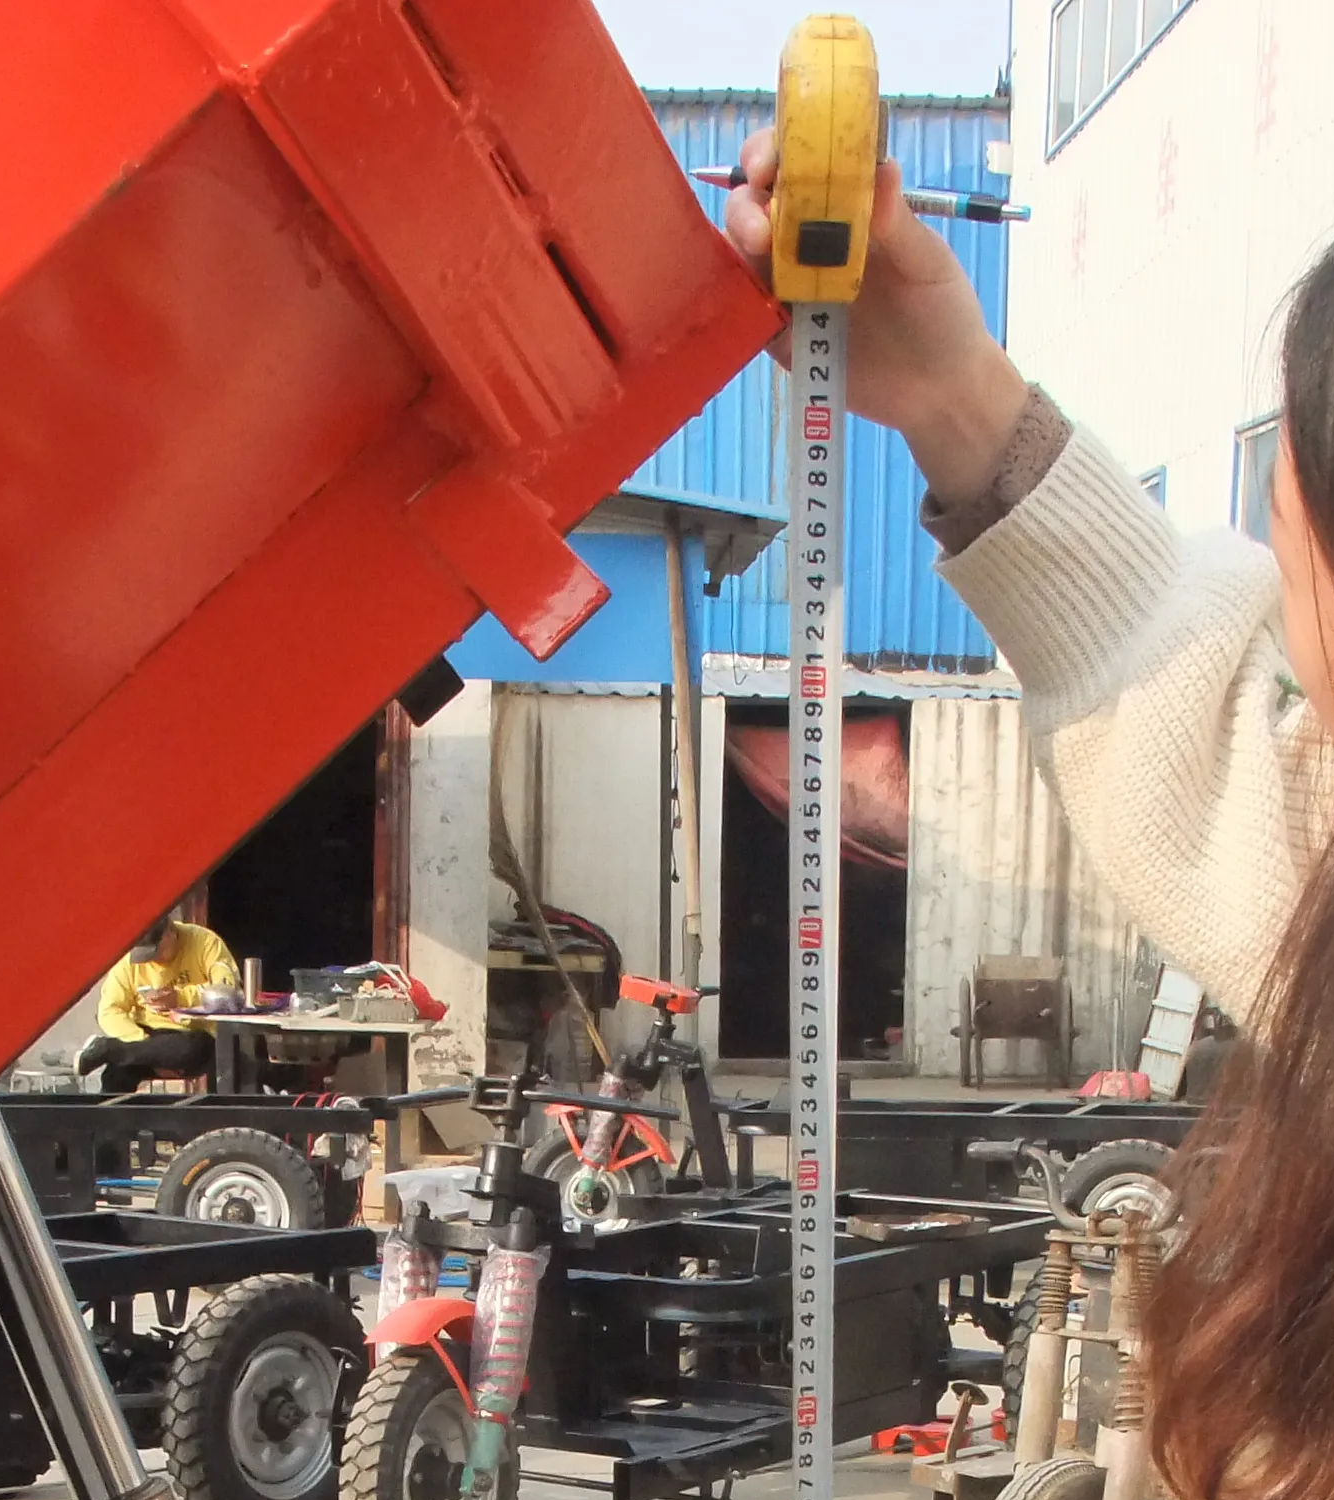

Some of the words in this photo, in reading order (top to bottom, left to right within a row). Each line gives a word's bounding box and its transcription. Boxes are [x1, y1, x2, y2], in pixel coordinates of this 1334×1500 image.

[810, 311, 830, 329] 4
[809, 339, 831, 355] 3
[809, 365, 830, 382] 2
[809, 394, 828, 406] 1
[806, 409, 829, 439] 90
[807, 444, 828, 461] 9
[807, 470, 828, 487] 8
[807, 497, 827, 512] 7
[806, 522, 827, 538] 6
[806, 548, 826, 564] 5
[806, 574, 826, 591] 4
[805, 600, 825, 616] 3
[805, 625, 825, 641] 2
[804, 653, 824, 665] 1
[803, 669, 825, 697] 80
[803, 701, 823, 718] 9
[803, 726, 823, 744] 8
[803, 752, 822, 768] 7
[803, 775, 822, 793] 6
[803, 801, 822, 819] 5
[802, 826, 821, 844] 4
[802, 852, 821, 868] 3
[801, 877, 821, 893] 2
[802, 904, 820, 916] 1
[800, 921, 820, 947] 70
[801, 951, 820, 967] 9
[801, 976, 819, 991] 8
[801, 1002, 819, 1016] 7
[801, 1024, 818, 1040] 6
[800, 1049, 818, 1064] 5
[801, 1073, 818, 1089] 4
[800, 1098, 818, 1113] 3
[800, 1122, 817, 1137] 2
[800, 1148, 817, 1159] 1
[800, 1164, 817, 1189] 60
[800, 1194, 816, 1209] 9
[800, 1217, 816, 1232] 8
[800, 1243, 816, 1257] 7
[799, 1265, 816, 1280] 6
[799, 1289, 815, 1304] 5
[800, 1312, 815, 1327] 4
[799, 1336, 815, 1351] 3
[799, 1360, 815, 1374] 2
[799, 1386, 815, 1397] 1
[799, 1399, 815, 1425] 50
[798, 1431, 813, 1446] 9
[798, 1453, 813, 1468] 8
[798, 1479, 813, 1489] 7
